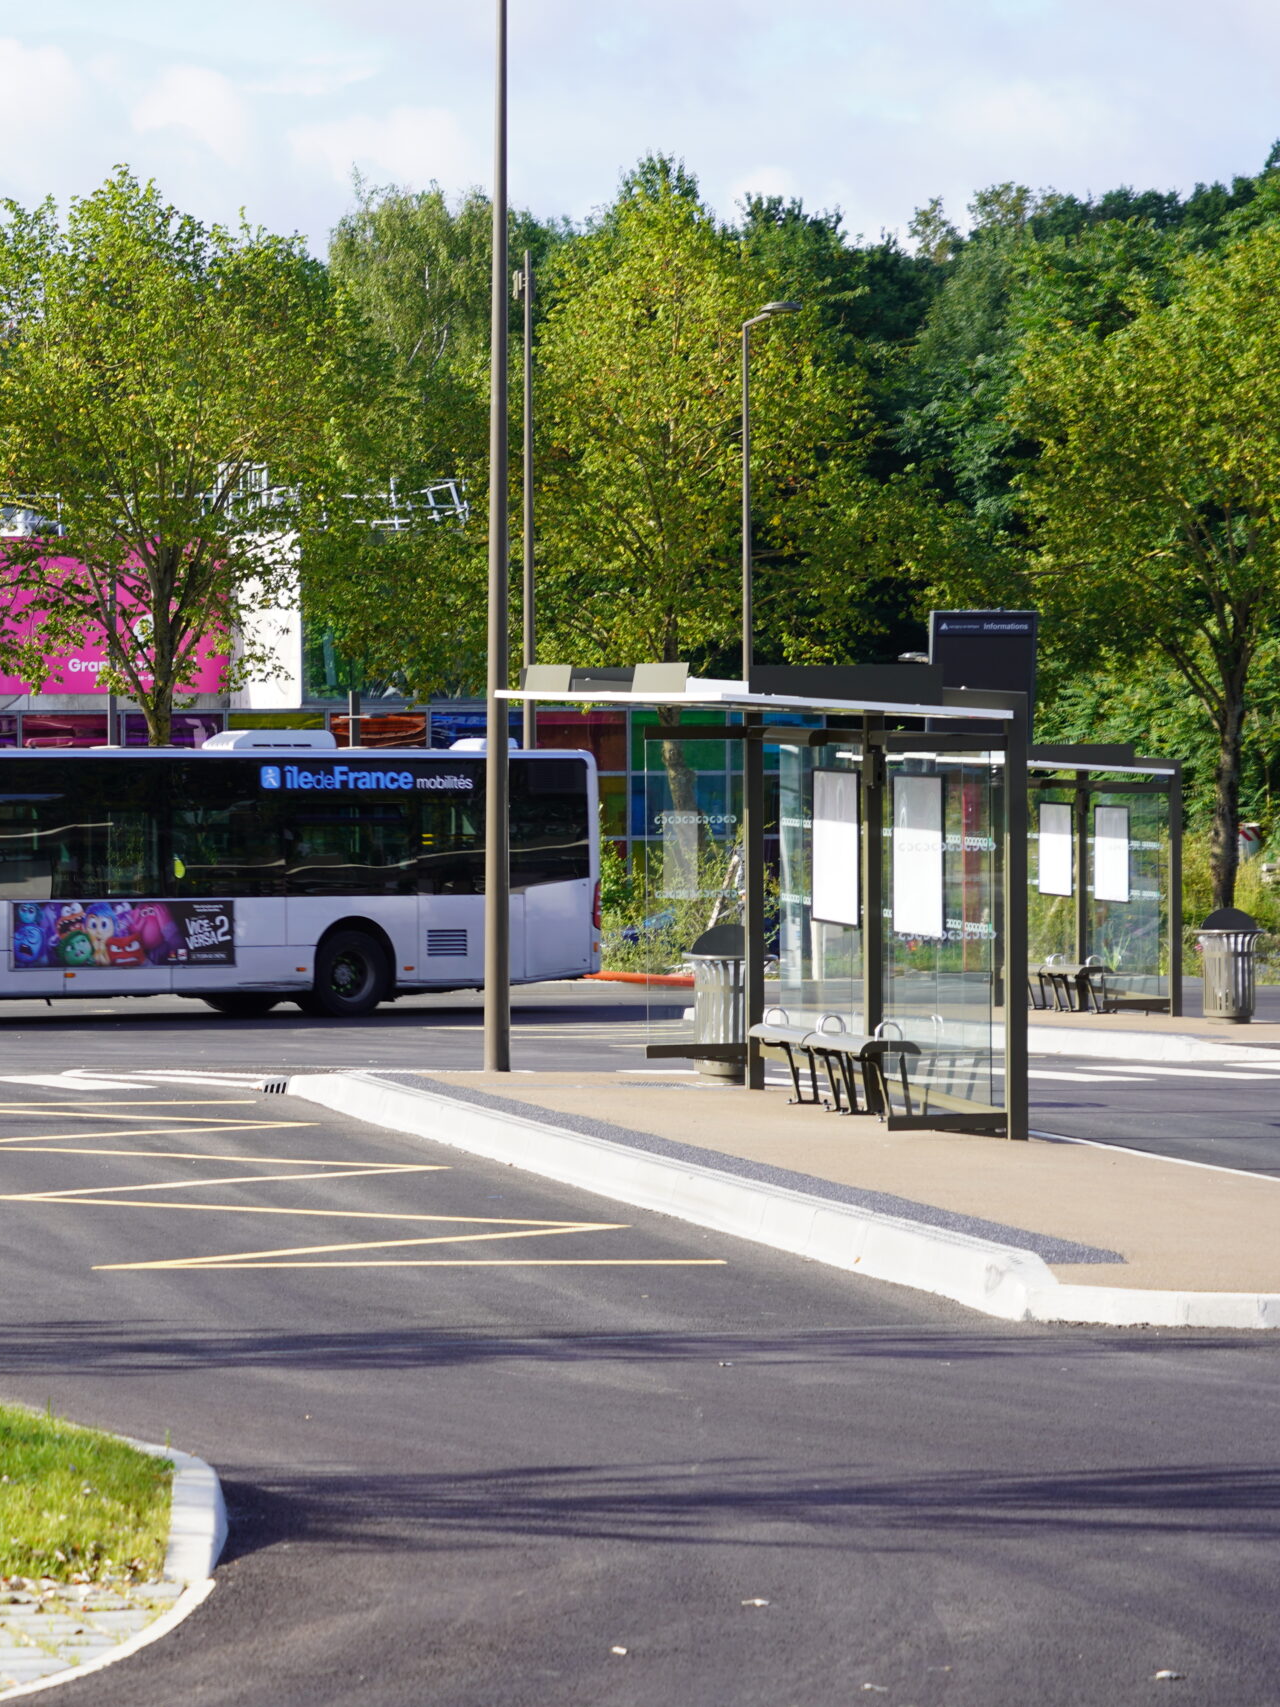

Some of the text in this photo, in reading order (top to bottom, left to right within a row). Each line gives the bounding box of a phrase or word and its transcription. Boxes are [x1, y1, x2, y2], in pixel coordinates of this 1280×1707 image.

[983, 622, 1029, 630] Informations
[416, 774, 473, 789] mobilités
[215, 915, 232, 942] 2
[185, 931, 219, 950] VERSA
